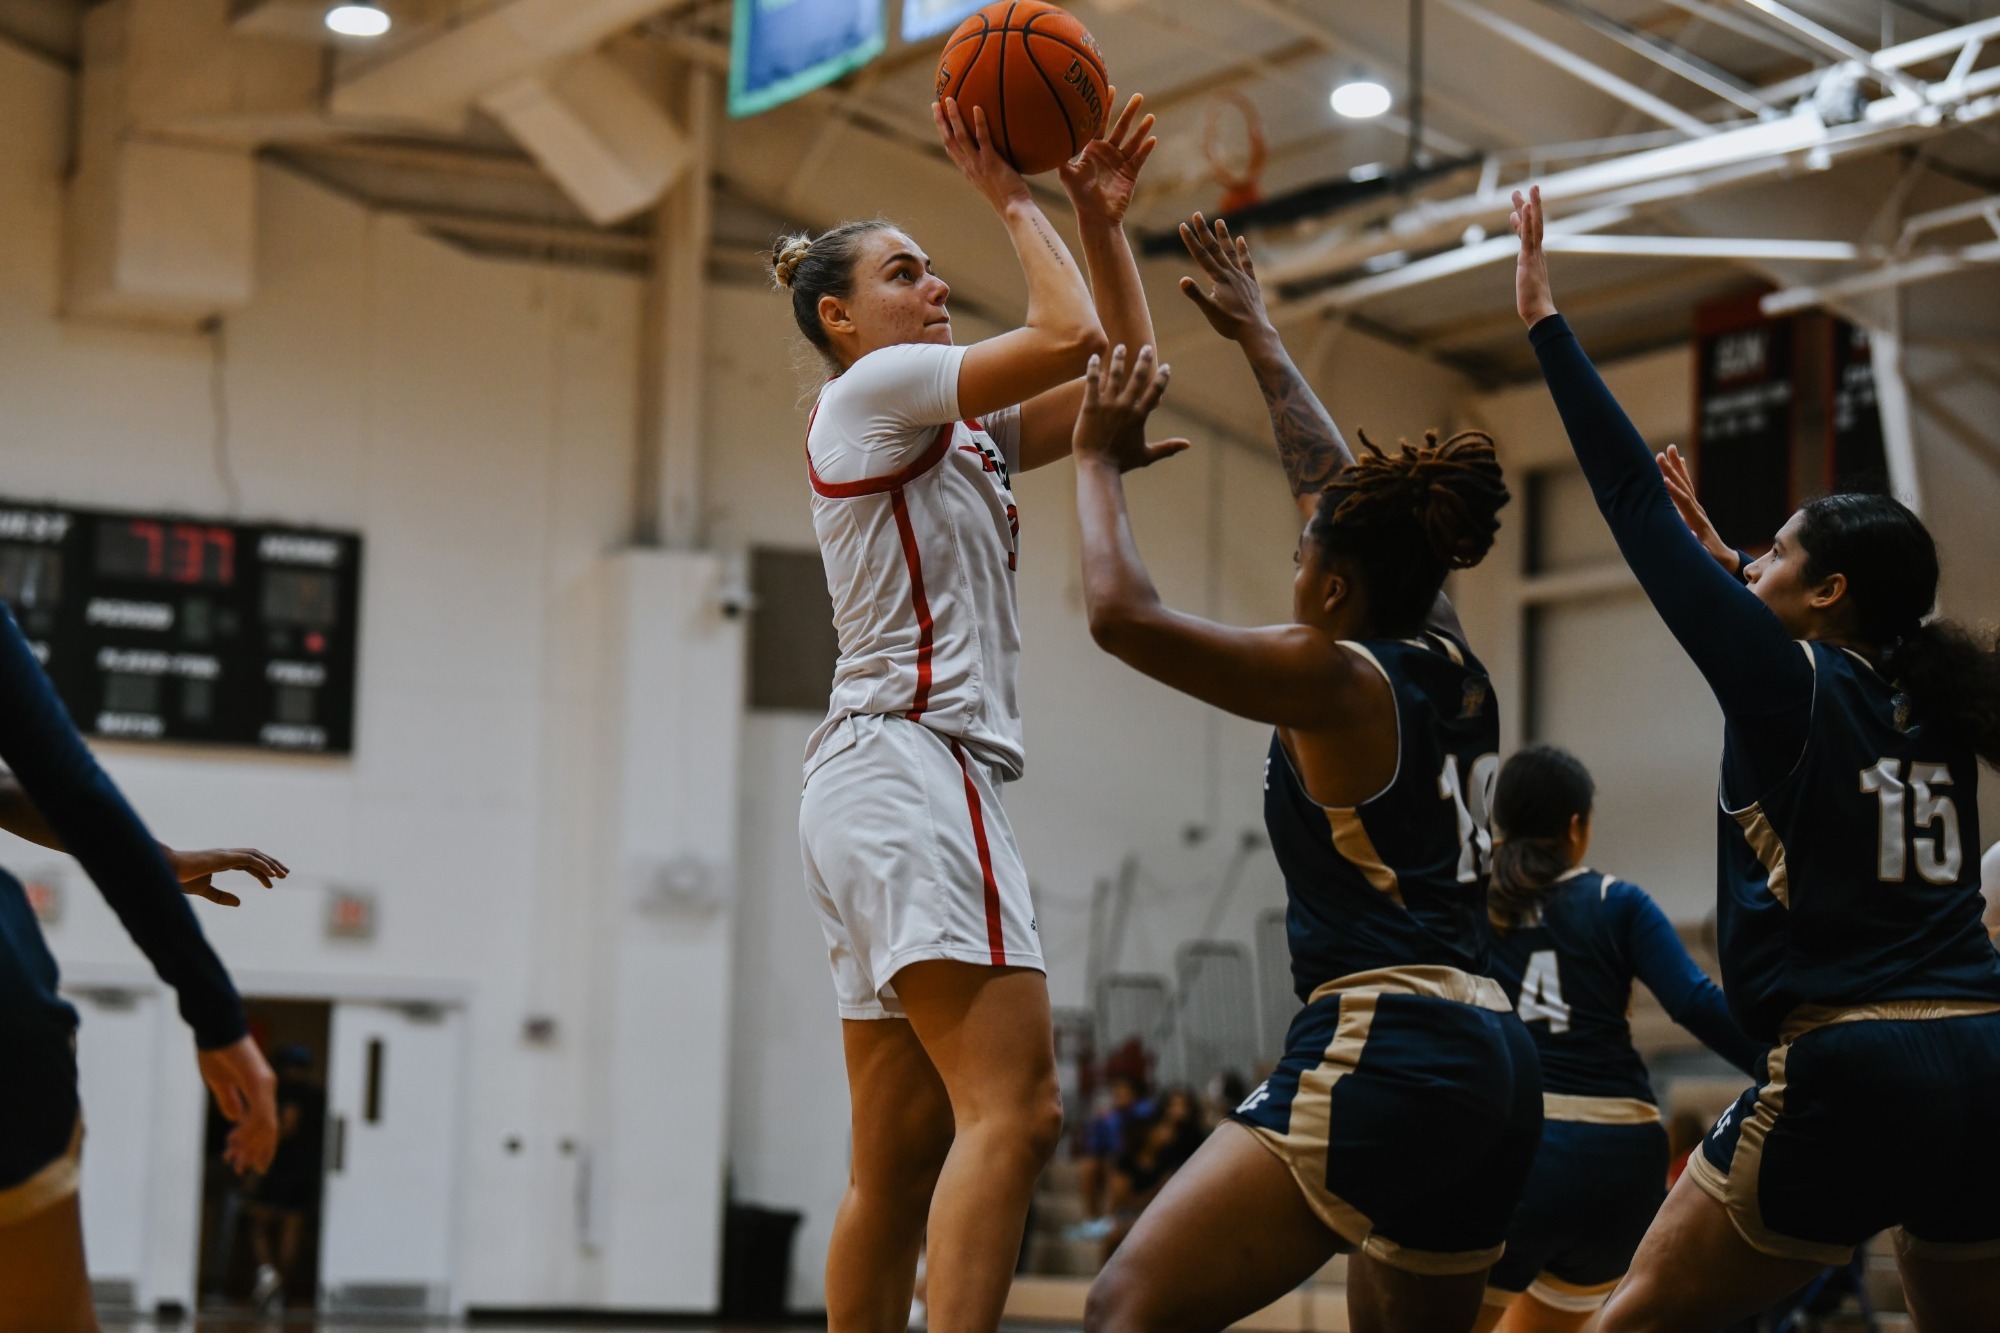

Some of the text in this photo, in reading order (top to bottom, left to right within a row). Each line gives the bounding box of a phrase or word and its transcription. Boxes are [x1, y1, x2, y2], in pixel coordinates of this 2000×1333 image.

[1064, 57, 1103, 131] LDING
[1859, 756, 1963, 885] 15
[1517, 950, 1571, 1034] 4
